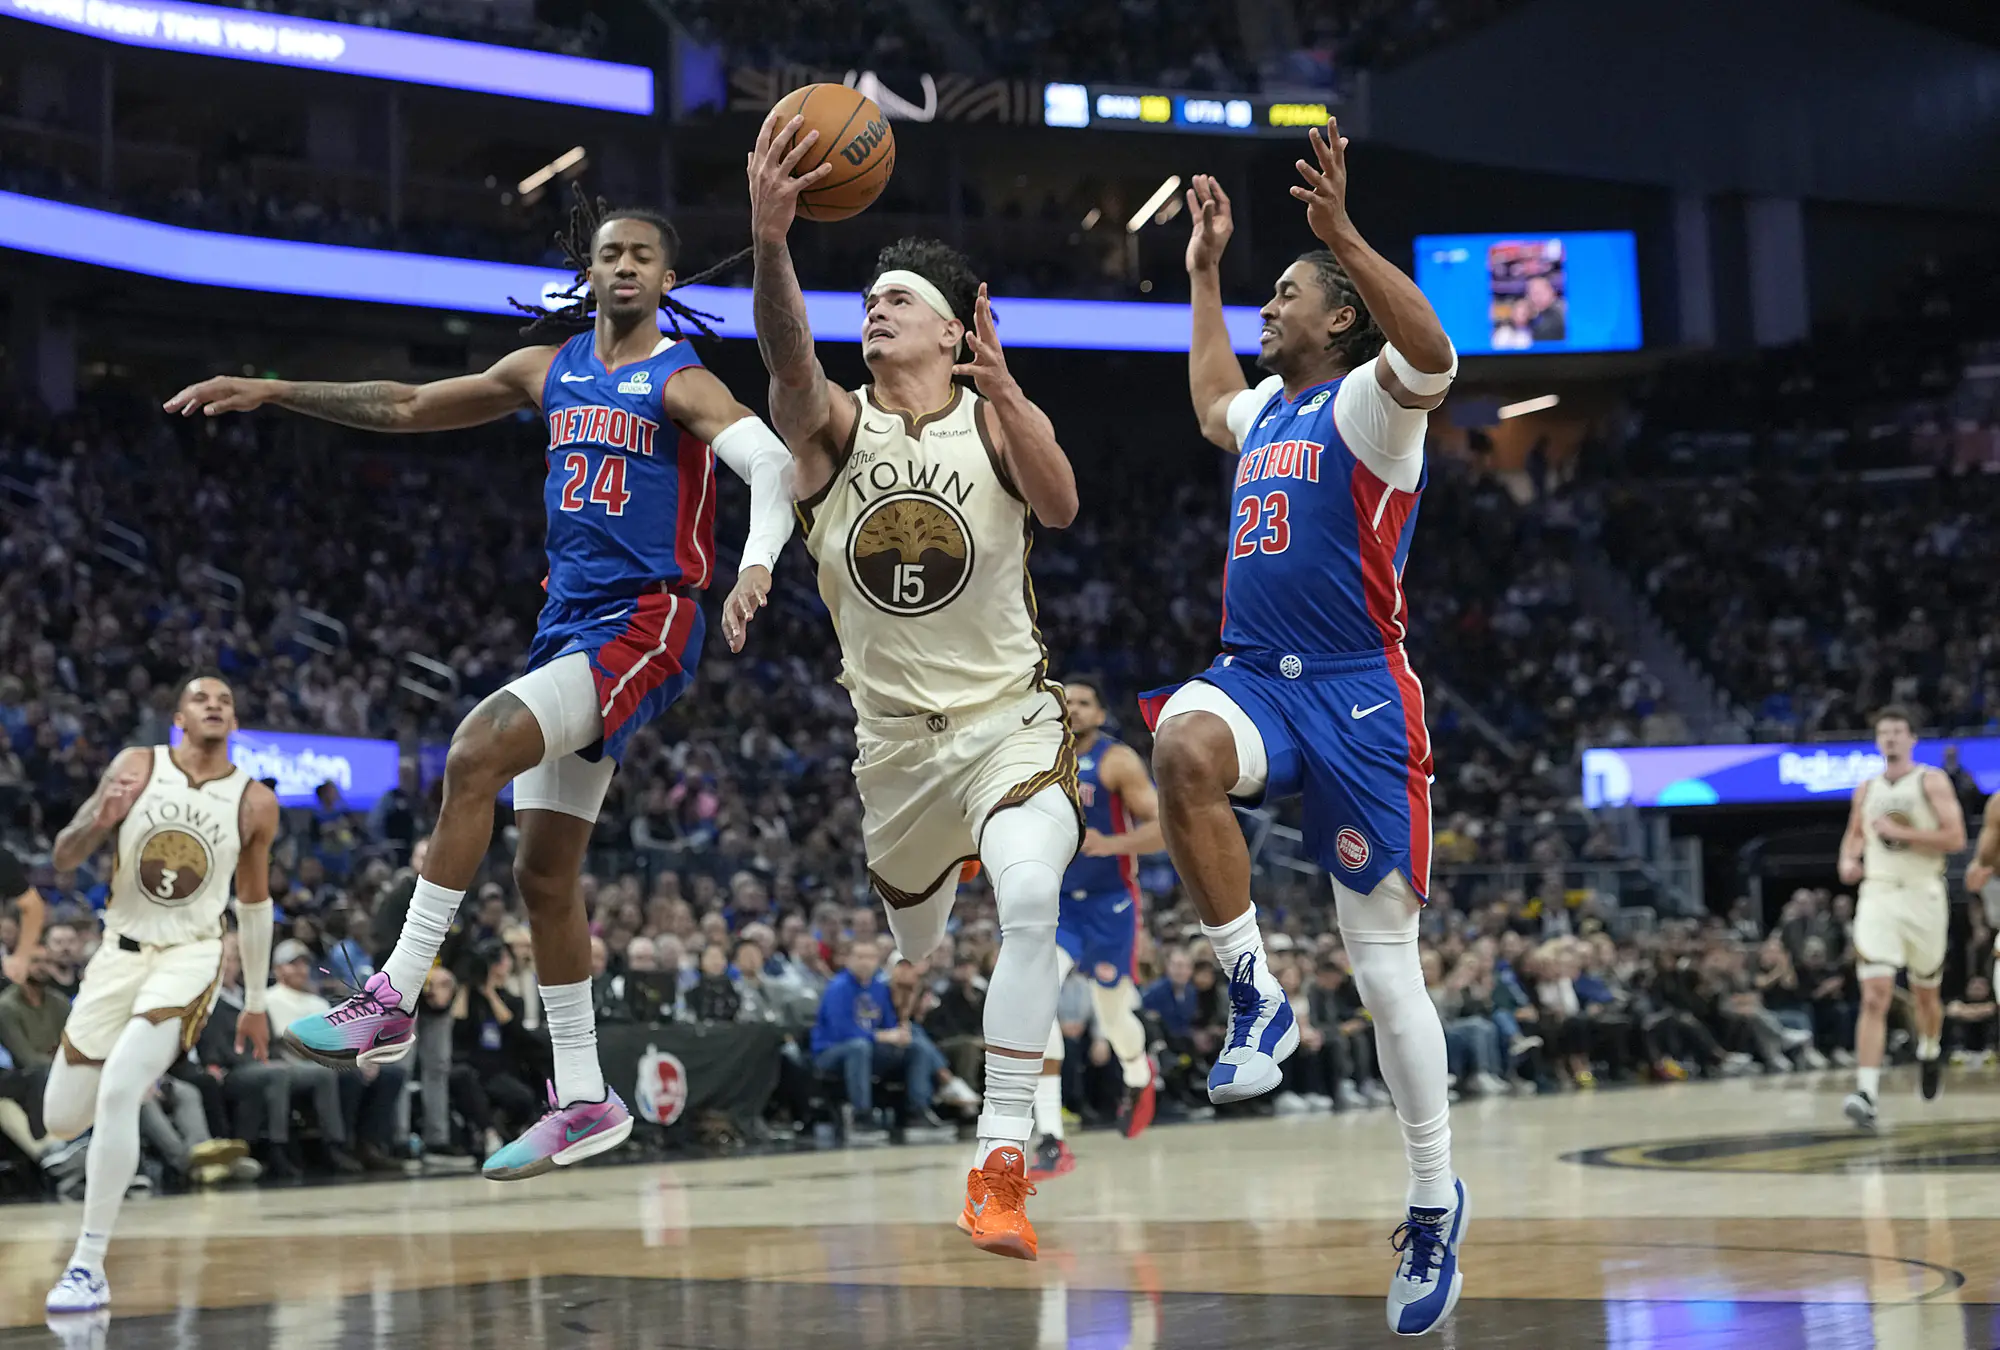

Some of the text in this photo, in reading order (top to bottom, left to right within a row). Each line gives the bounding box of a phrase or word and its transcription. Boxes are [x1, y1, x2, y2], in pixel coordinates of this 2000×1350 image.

[841, 113, 889, 166] Wilso
[549, 404, 660, 456] DETROIT
[850, 450, 876, 469] The
[560, 452, 632, 516] 24
[848, 459, 975, 507] TOWN
[1232, 490, 1291, 560] 23
[892, 563, 925, 604] 15
[1779, 750, 1887, 792] Rakute
[139, 801, 228, 845] TOWN
[155, 867, 179, 899] 3
